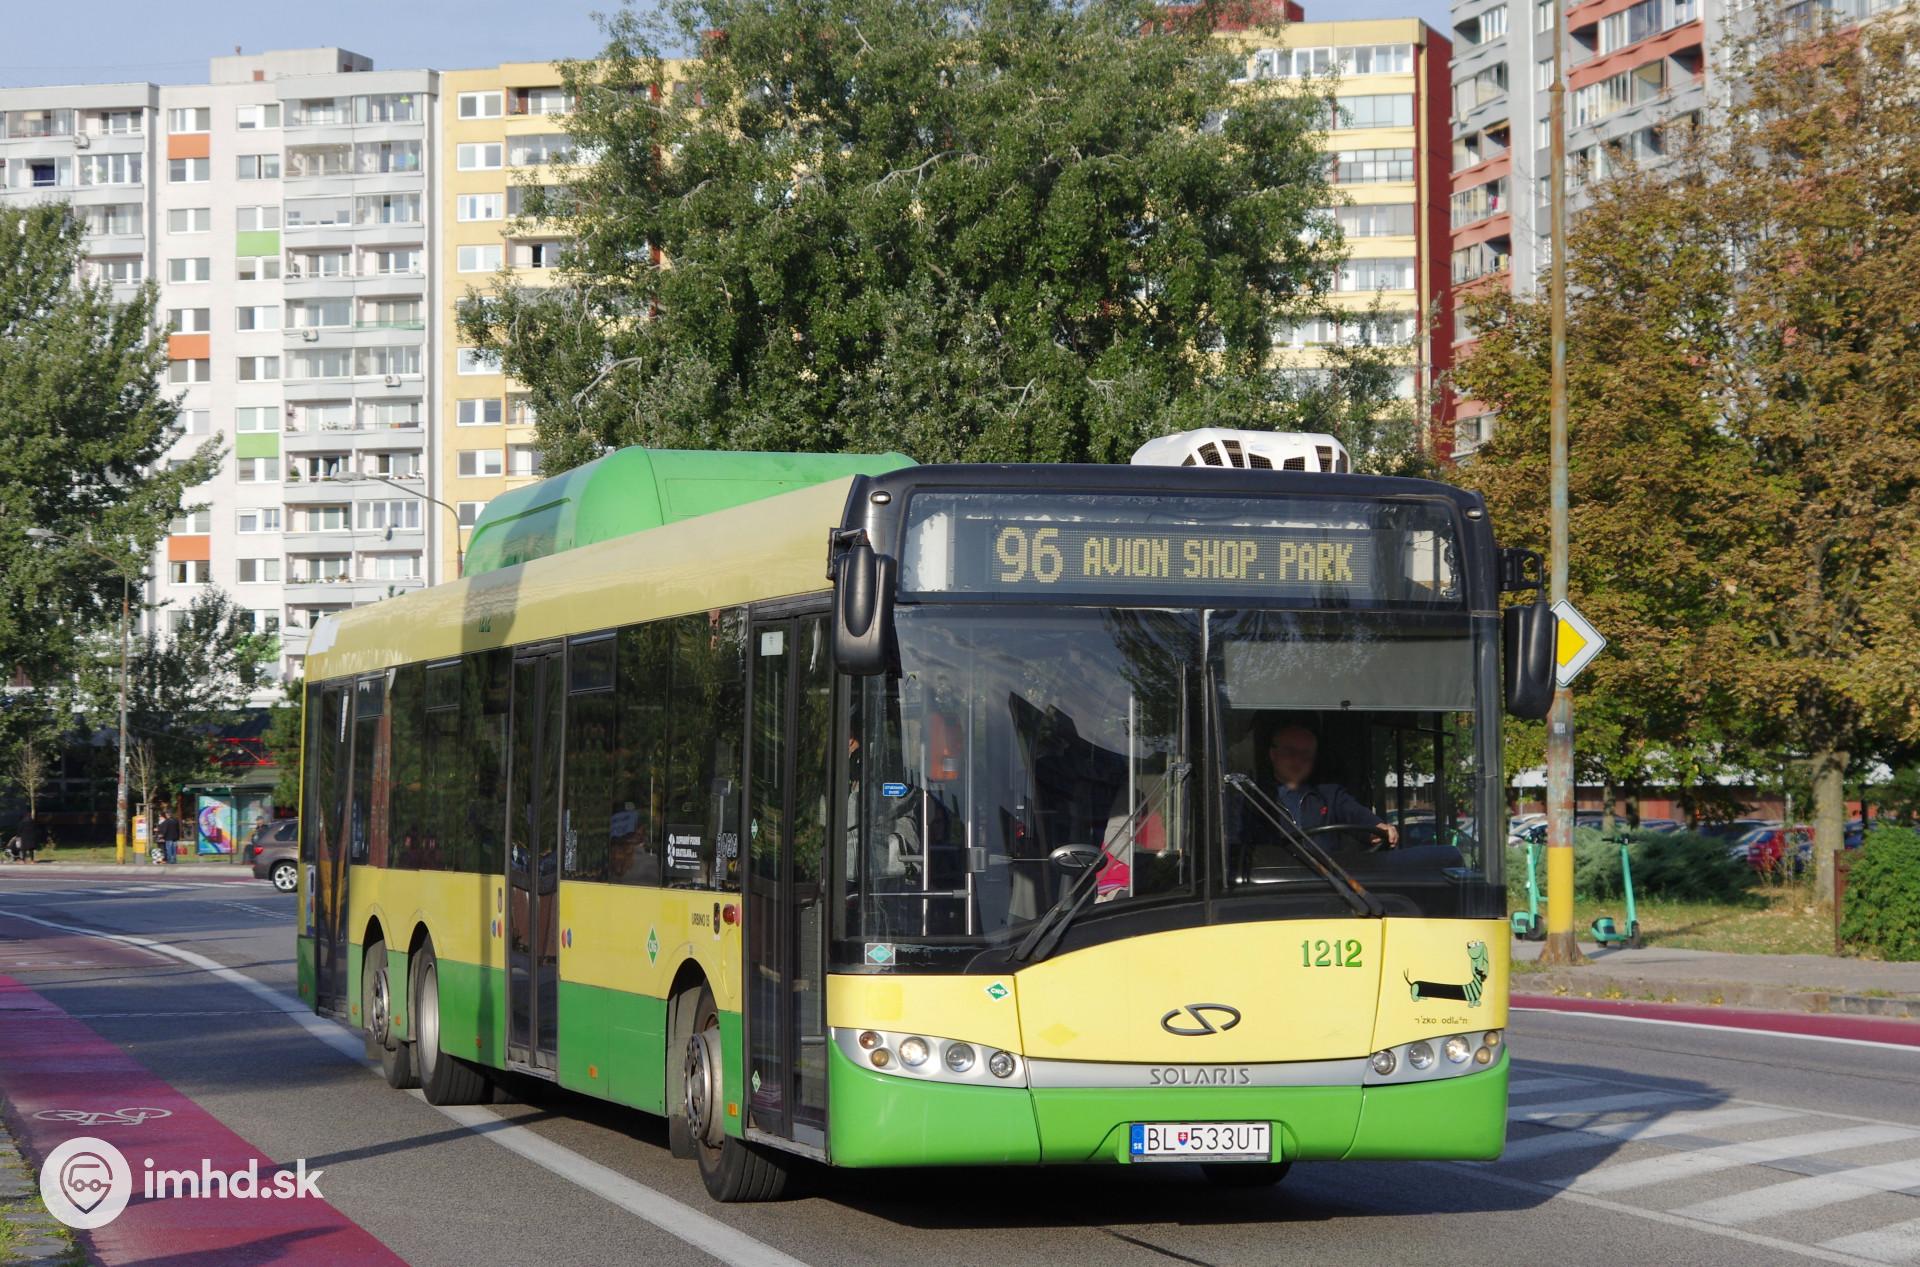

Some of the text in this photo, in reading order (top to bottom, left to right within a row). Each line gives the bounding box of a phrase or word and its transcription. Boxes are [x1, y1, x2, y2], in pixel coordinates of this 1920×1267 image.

[996, 526, 1353, 583] 96 AVION SHOP. PARK
[1301, 939, 1363, 967] 1212
[1150, 1068, 1250, 1084] SOLARIS
